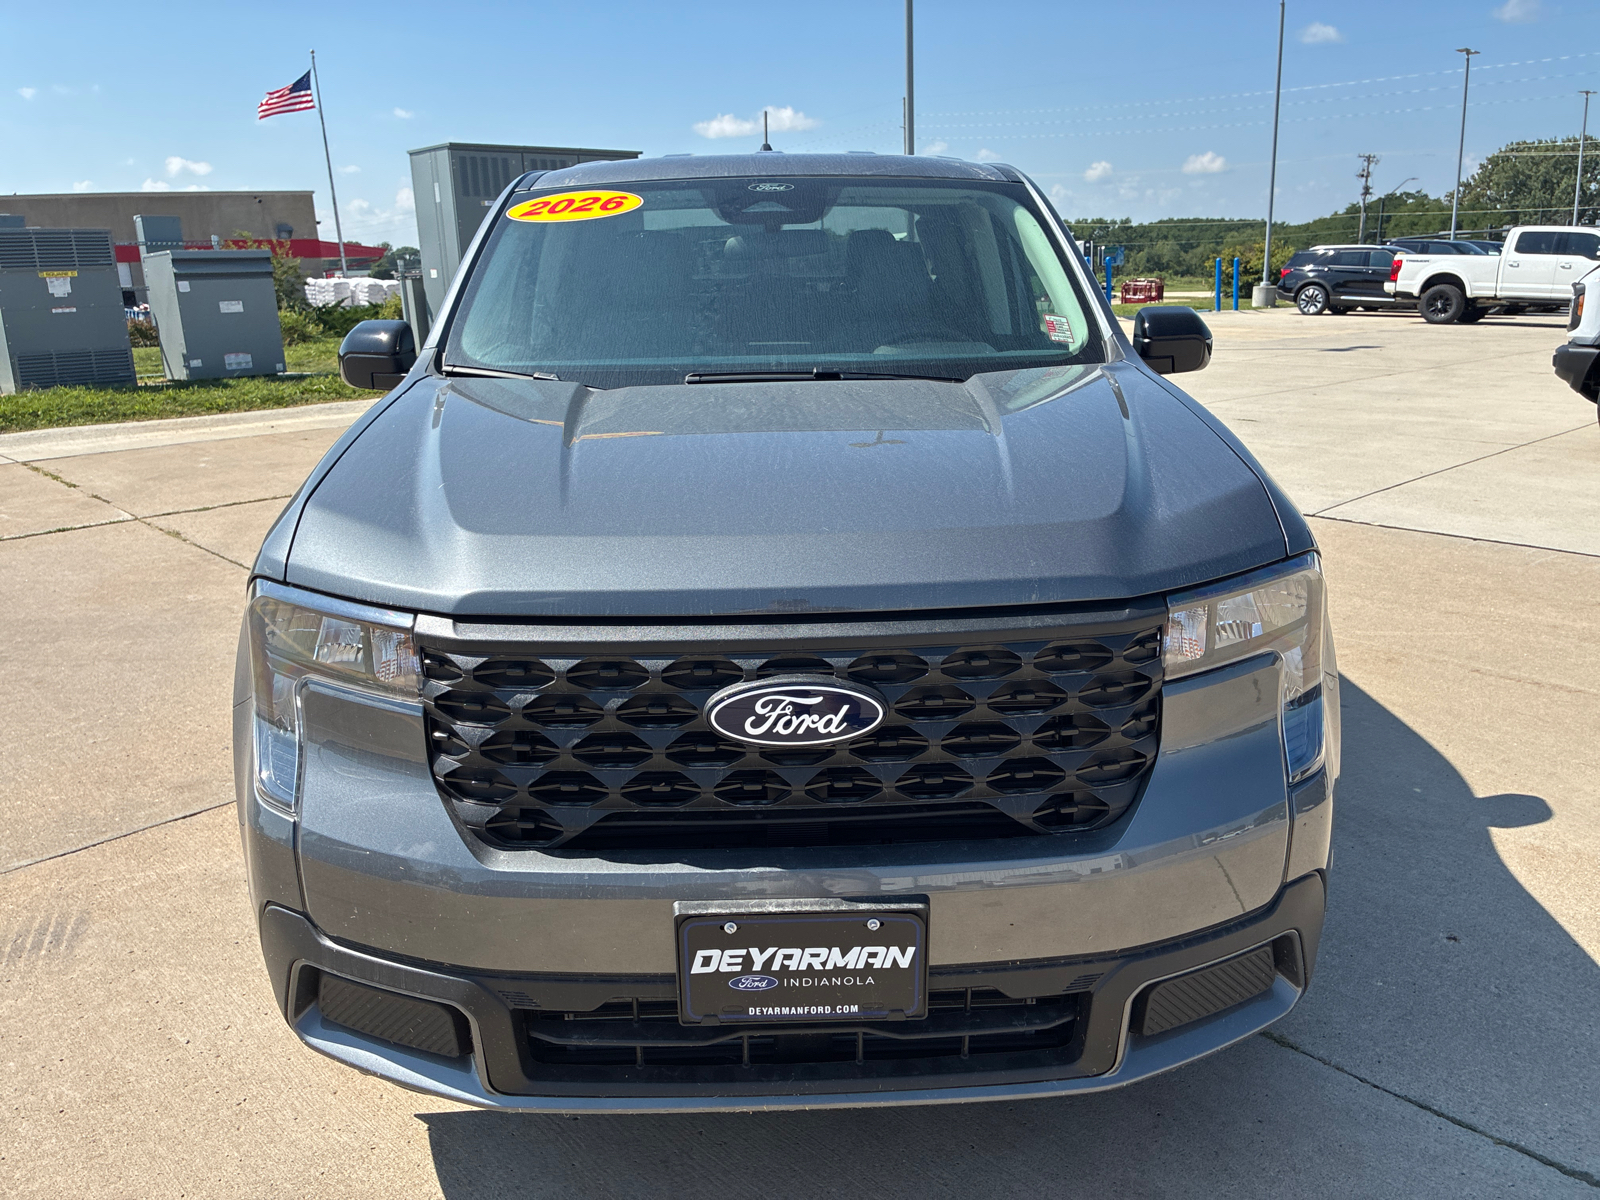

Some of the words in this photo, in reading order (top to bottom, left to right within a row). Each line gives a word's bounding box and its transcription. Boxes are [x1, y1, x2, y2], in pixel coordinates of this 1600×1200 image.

[518, 196, 629, 217] 2026
[744, 695, 850, 735] Ford
[690, 946, 916, 974] DEYARMAN
[738, 976, 768, 989] Ford
[784, 976, 875, 987] INDIANOLA
[748, 1004, 859, 1016] DEYARMANFORD.COM
